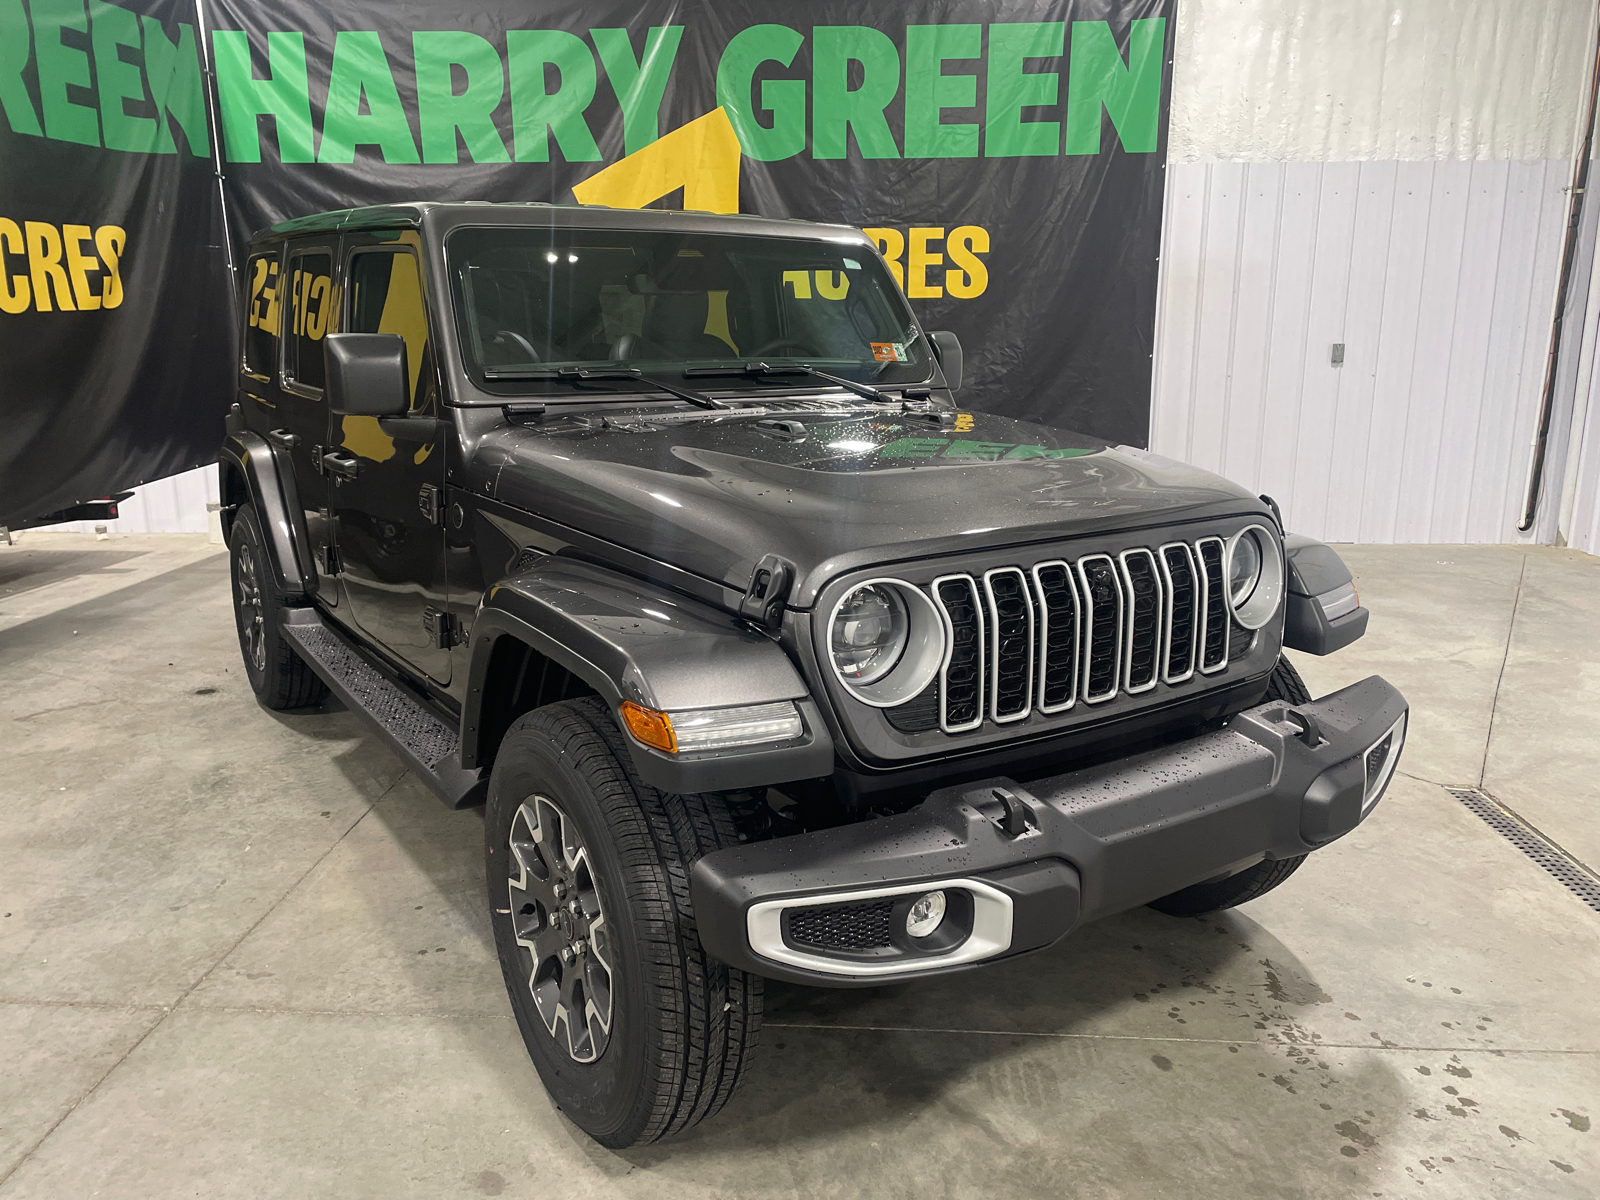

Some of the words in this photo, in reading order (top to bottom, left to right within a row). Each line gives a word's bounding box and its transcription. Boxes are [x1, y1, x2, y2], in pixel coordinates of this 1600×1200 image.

[213, 25, 685, 163] HARRY
[716, 17, 1166, 162] GREEN
[0, 217, 126, 313] CRES
